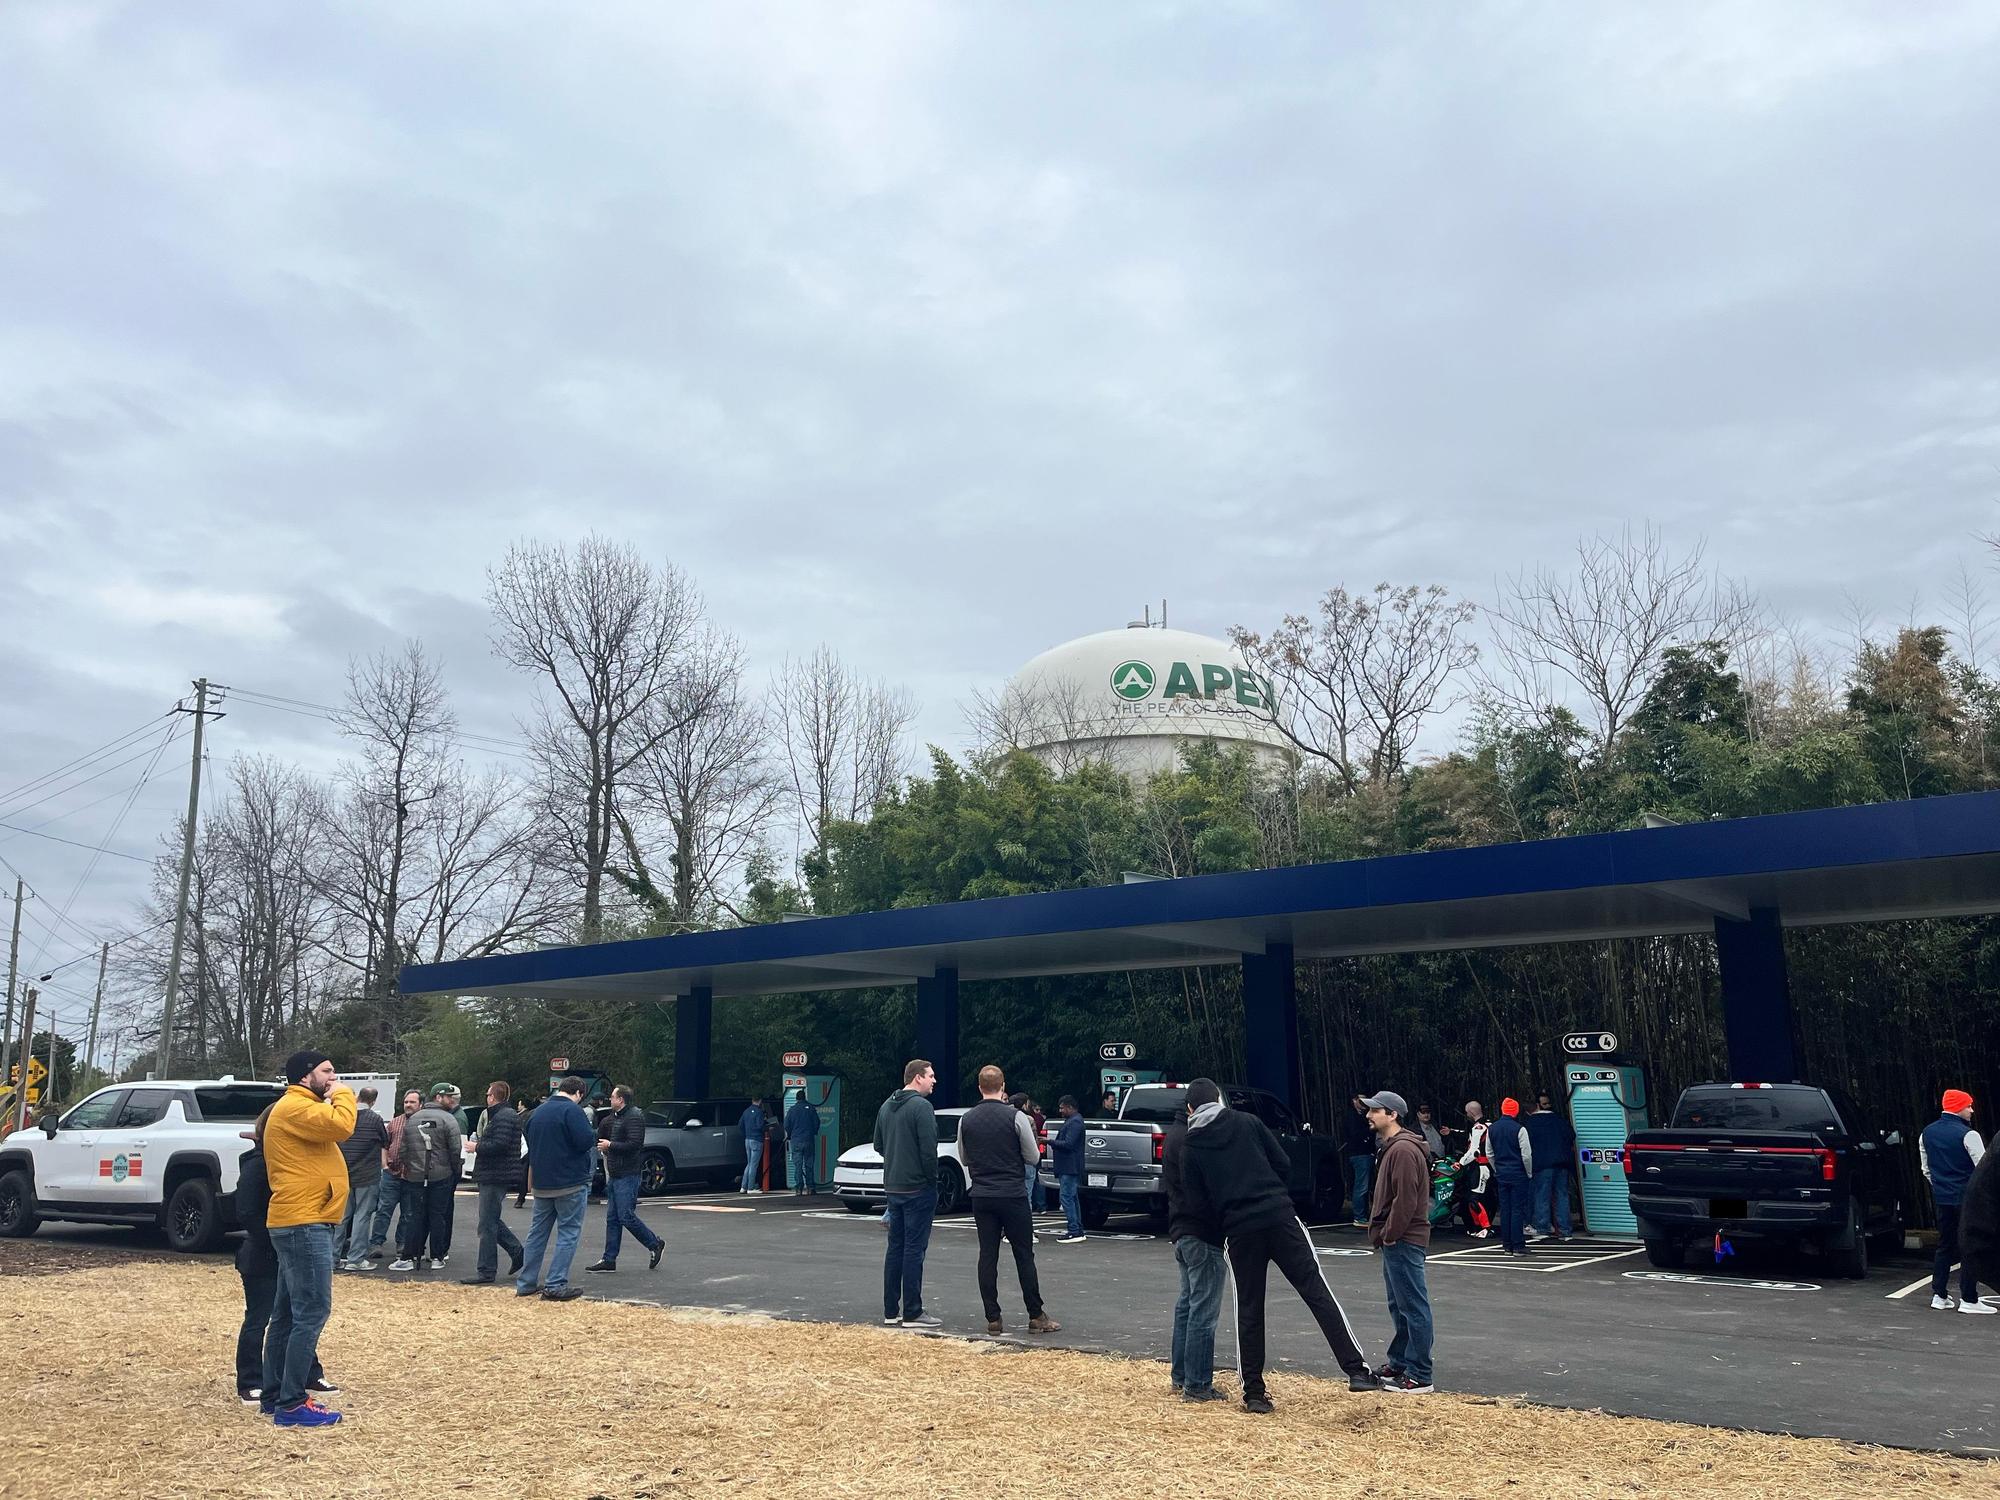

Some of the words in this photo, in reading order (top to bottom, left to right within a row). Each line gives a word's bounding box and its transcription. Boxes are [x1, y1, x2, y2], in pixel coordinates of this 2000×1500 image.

[1163, 662, 1278, 711] APEX
[1113, 703, 1141, 714] THE
[1148, 703, 1186, 714] PEAK
[1193, 704, 1211, 715] OF
[1568, 1037, 1588, 1049] CCS
[1603, 1037, 1612, 1048] 4
[1103, 1047, 1117, 1057] CCS
[1126, 1046, 1131, 1056] 3
[784, 1055, 799, 1063] NACS
[800, 1055, 805, 1063] 2
